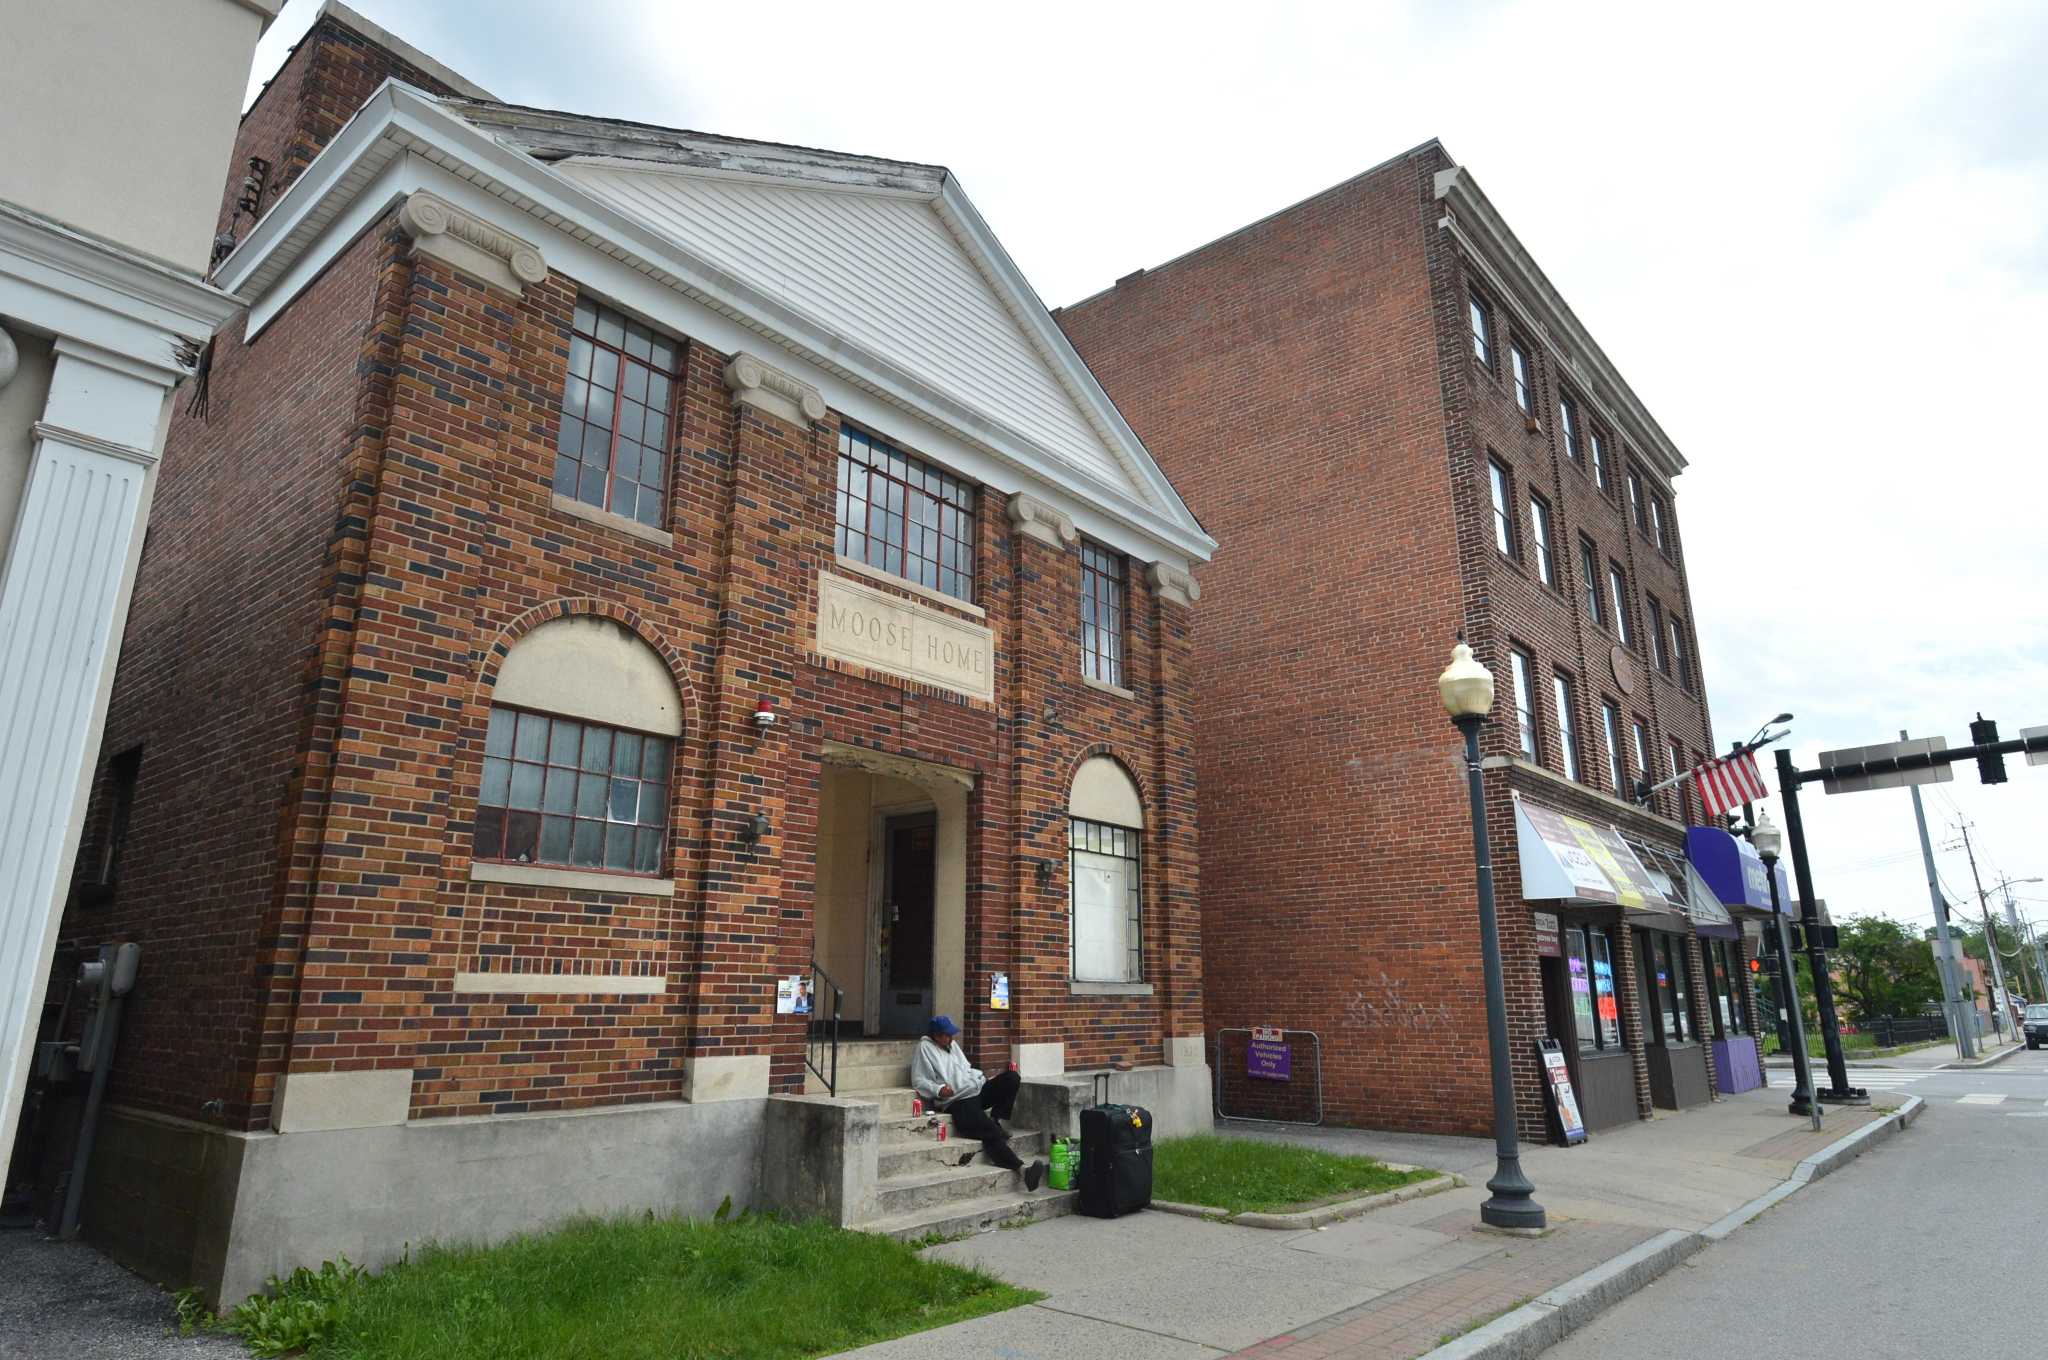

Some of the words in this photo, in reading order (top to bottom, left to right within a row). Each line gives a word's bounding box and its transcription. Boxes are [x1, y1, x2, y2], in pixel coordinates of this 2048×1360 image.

[831, 604, 912, 652] MOOSE
[927, 635, 985, 674] HOME
[1251, 1041, 1287, 1052] Authorized
[1255, 1050, 1282, 1060] Vehicles
[1261, 1059, 1276, 1069] Only
